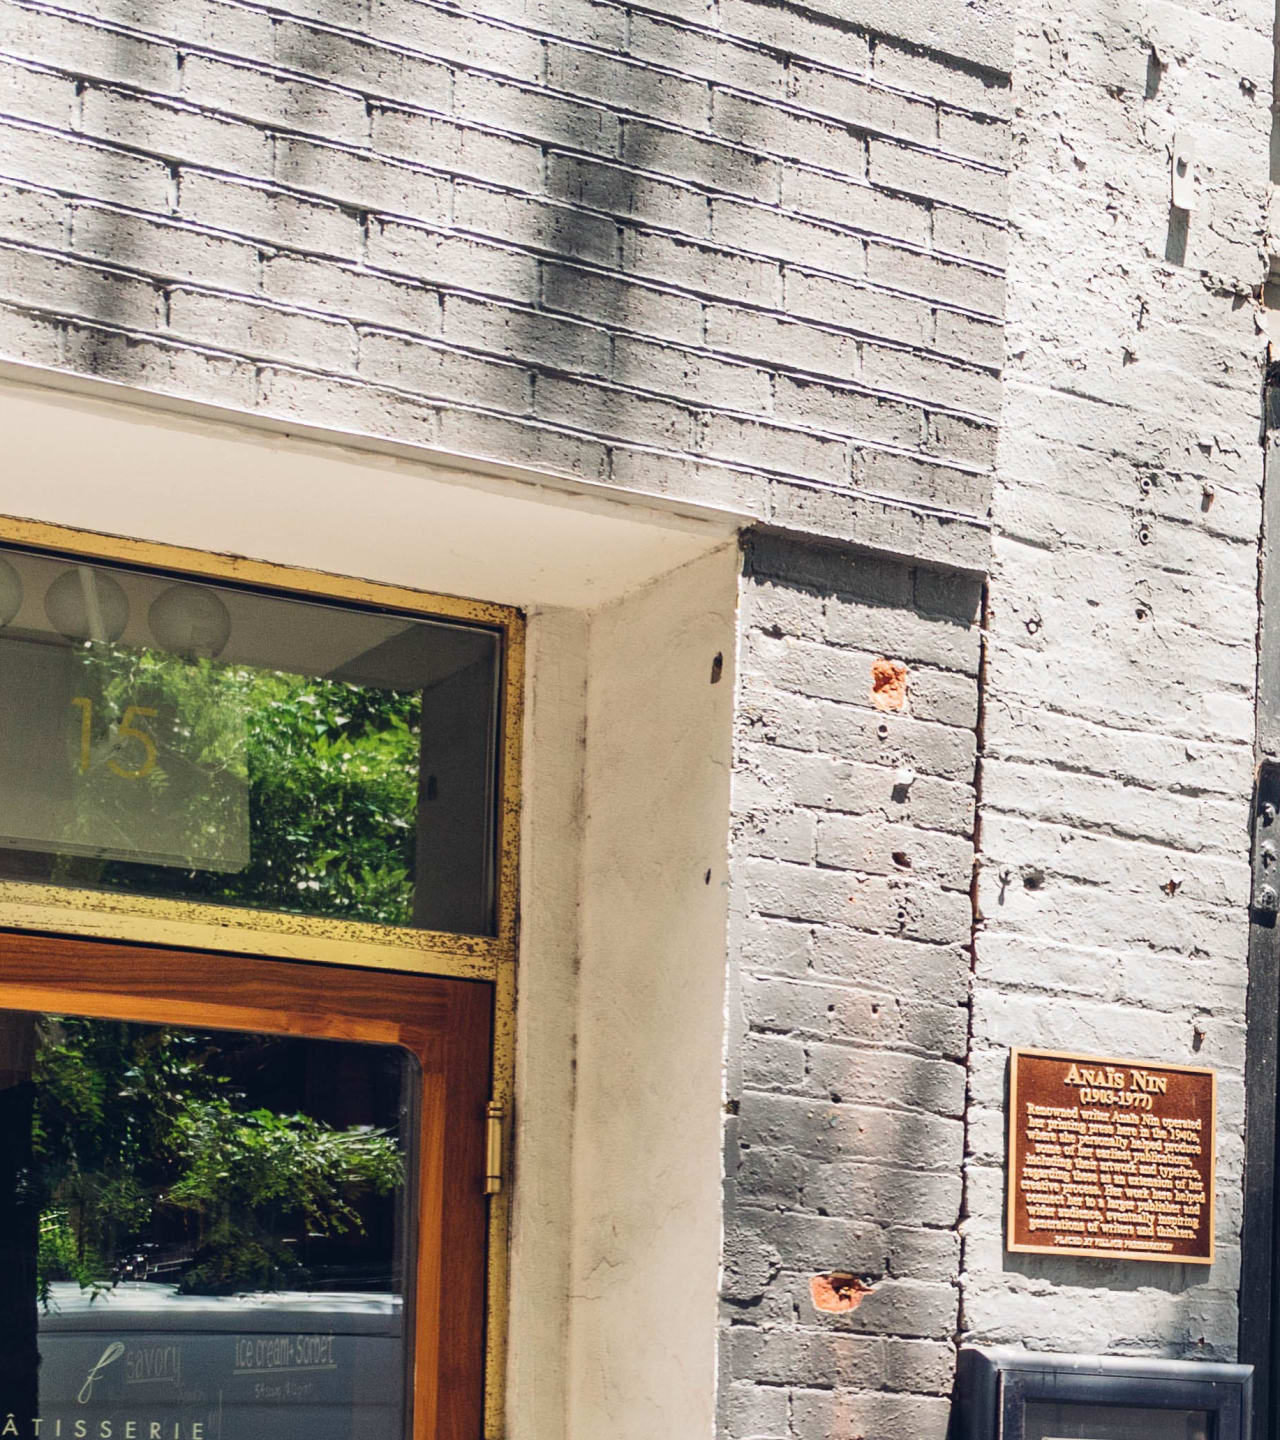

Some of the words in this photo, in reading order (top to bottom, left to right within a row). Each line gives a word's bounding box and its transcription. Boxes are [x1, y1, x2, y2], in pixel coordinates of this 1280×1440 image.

[72, 697, 158, 780] 15
[1130, 1070, 1167, 1093] NIN
[1080, 1088, 1152, 1110] (1903-1977)
[1026, 1102, 1078, 1118] Renowned
[1080, 1109, 1110, 1120] writer
[1141, 1113, 1160, 1126] Nin
[1162, 1118, 1201, 1130] operated
[1027, 1115, 1046, 1127] her
[1047, 1118, 1086, 1133] printing
[1088, 1123, 1114, 1134] press
[1116, 1124, 1137, 1136] here
[1140, 1125, 1149, 1137] in
[1152, 1127, 1167, 1138] the
[1170, 1128, 1200, 1143] 1940s,
[1026, 1129, 1057, 1141] where
[1059, 1131, 1076, 1142] she
[1078, 1135, 1128, 1149] personally
[1130, 1137, 1162, 1150] helped
[1164, 1142, 1201, 1154] produce
[1035, 1143, 1061, 1154] some
[1064, 1144, 1076, 1155] of
[1078, 1144, 1094, 1157] her
[1096, 1147, 1131, 1159] earliest
[1025, 1152, 1072, 1169] including
[1099, 1161, 1137, 1174] artwork
[1139, 1164, 1157, 1175] and
[1022, 1168, 1071, 1182] regarding
[1072, 1170, 1098, 1182] these
[1100, 1174, 1112, 1183] as
[1113, 1175, 1125, 1184] an
[1128, 1176, 1173, 1188] extension
[1175, 1179, 1187, 1189] of
[1188, 1179, 1204, 1190] her
[1021, 1180, 1060, 1191] creative
[1104, 1184, 1122, 1196] Her
[1124, 1187, 1150, 1198] work
[1151, 1188, 1172, 1200] here
[1174, 1189, 1206, 1204] helped
[1026, 1193, 1064, 1205] connect
[1066, 1193, 1084, 1206] her
[1085, 1196, 1096, 1207] to
[1098, 1198, 1105, 1207] a
[1106, 1196, 1135, 1211] larger
[1137, 1199, 1181, 1213] publisher
[1183, 1203, 1200, 1215] and
[1026, 1204, 1056, 1216] wider
[1106, 1211, 1155, 1227] eventually
[1157, 1213, 1199, 1229] inspiring
[1029, 1218, 1085, 1231] generations
[1087, 1221, 1100, 1232] of
[1100, 1222, 1135, 1235] writers
[1136, 1224, 1155, 1236] and
